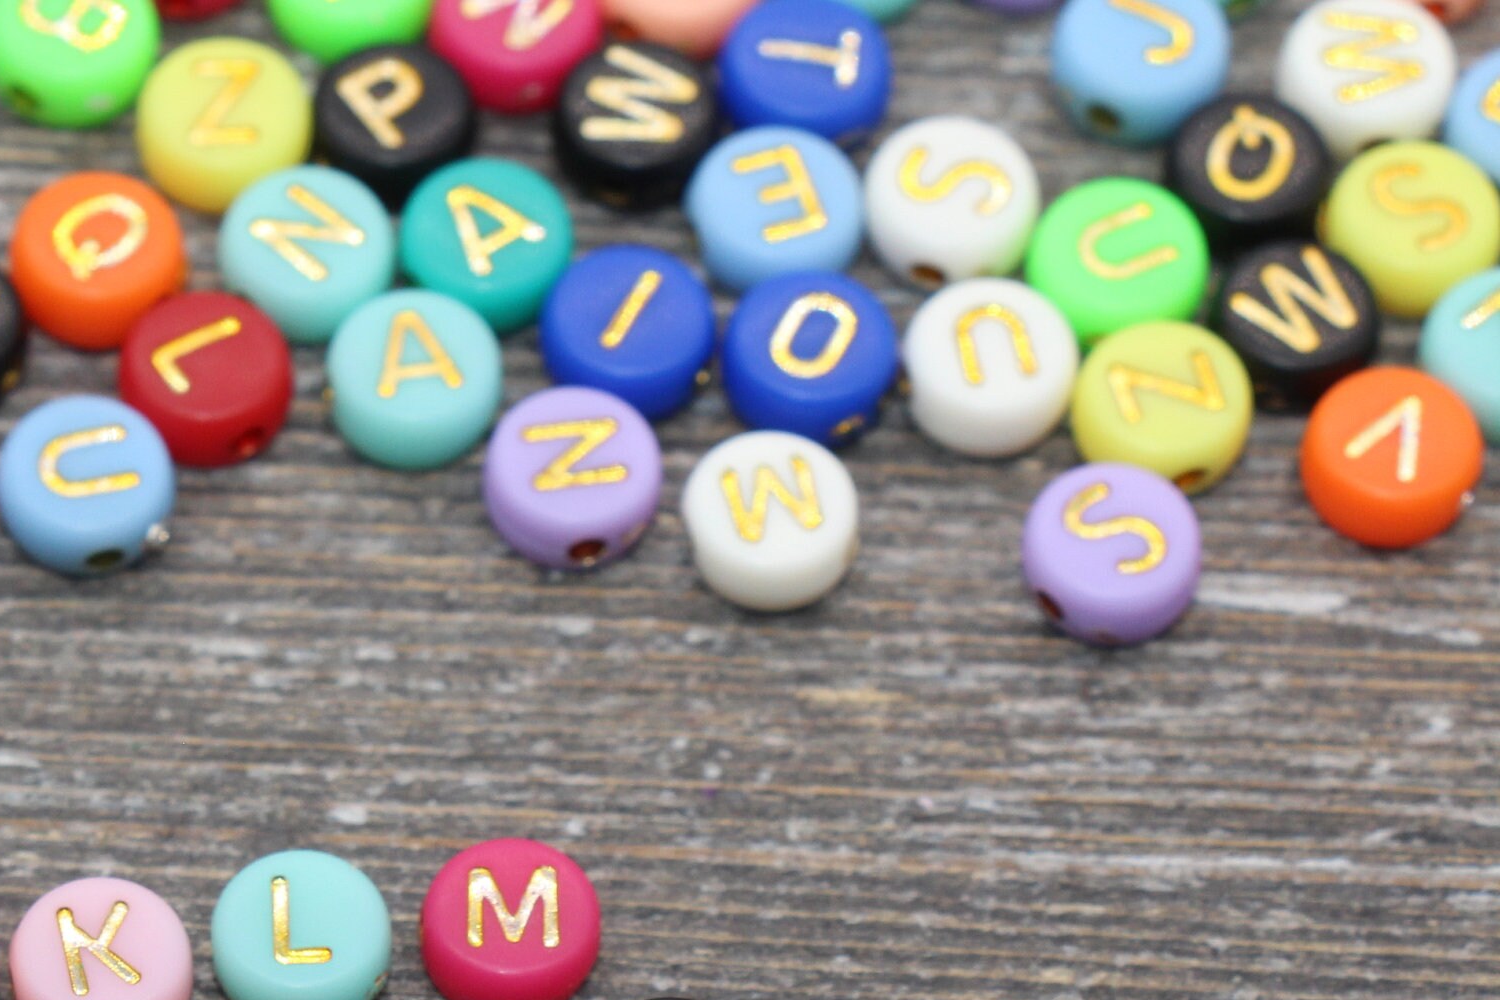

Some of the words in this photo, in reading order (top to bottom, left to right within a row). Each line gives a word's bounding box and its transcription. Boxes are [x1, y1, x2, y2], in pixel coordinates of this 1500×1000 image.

[189, 59, 260, 147] Z
[336, 57, 424, 149] P
[757, 29, 862, 89] T
[731, 144, 828, 244] E
[897, 147, 1012, 216] S
[1206, 105, 1295, 202] Q
[52, 193, 148, 280] Q
[446, 185, 547, 277] A
[1078, 202, 1180, 281] U
[1372, 161, 1468, 252] S
[377, 309, 464, 399] A
[599, 270, 662, 349] I
[770, 291, 858, 380] O
[151, 316, 241, 394] L
[38, 424, 141, 498] U
[1064, 484, 1168, 574] S
[56, 900, 142, 997] K
[270, 875, 332, 965] L
[466, 866, 559, 949] M
